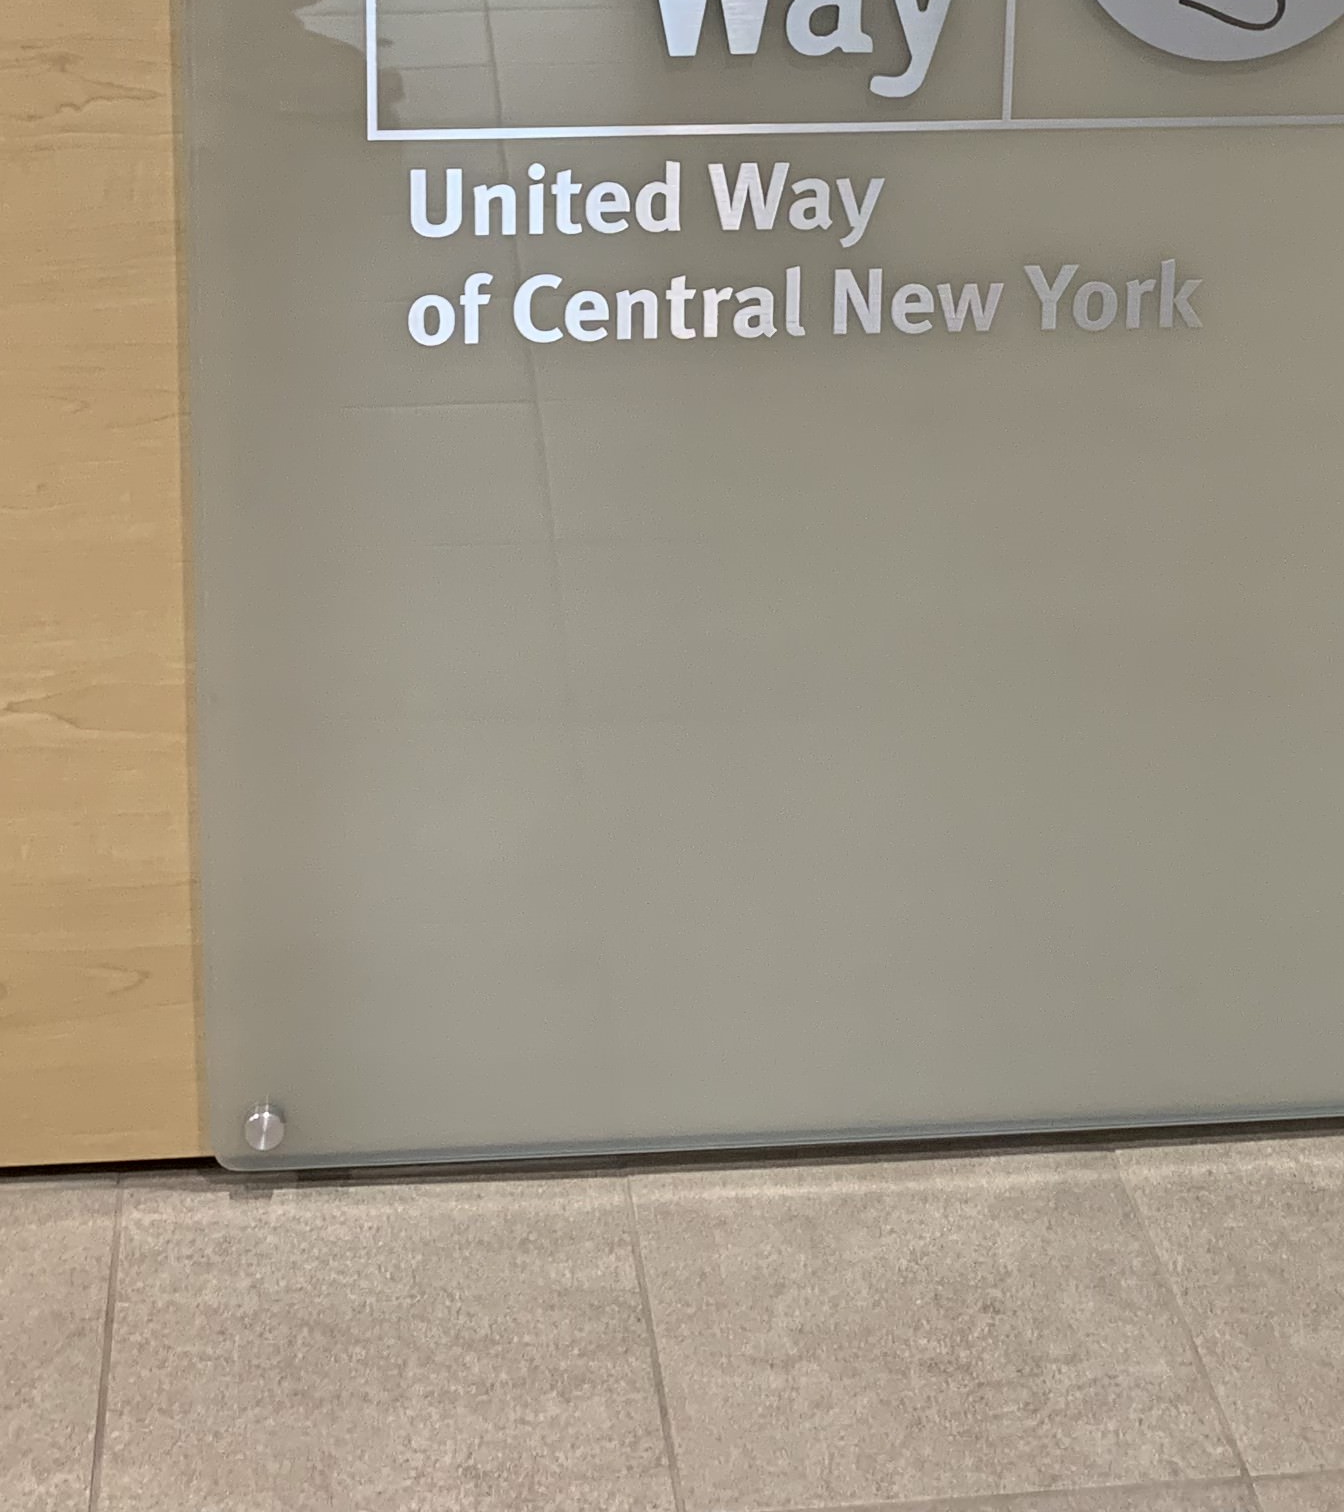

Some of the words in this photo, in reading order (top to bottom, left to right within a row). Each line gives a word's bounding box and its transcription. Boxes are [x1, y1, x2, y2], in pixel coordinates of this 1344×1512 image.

[408, 160, 681, 236] United
[708, 161, 885, 247] Way
[408, 272, 490, 346] of
[513, 266, 805, 343] Central
[832, 269, 1004, 336] New
[1025, 258, 1203, 333] York
